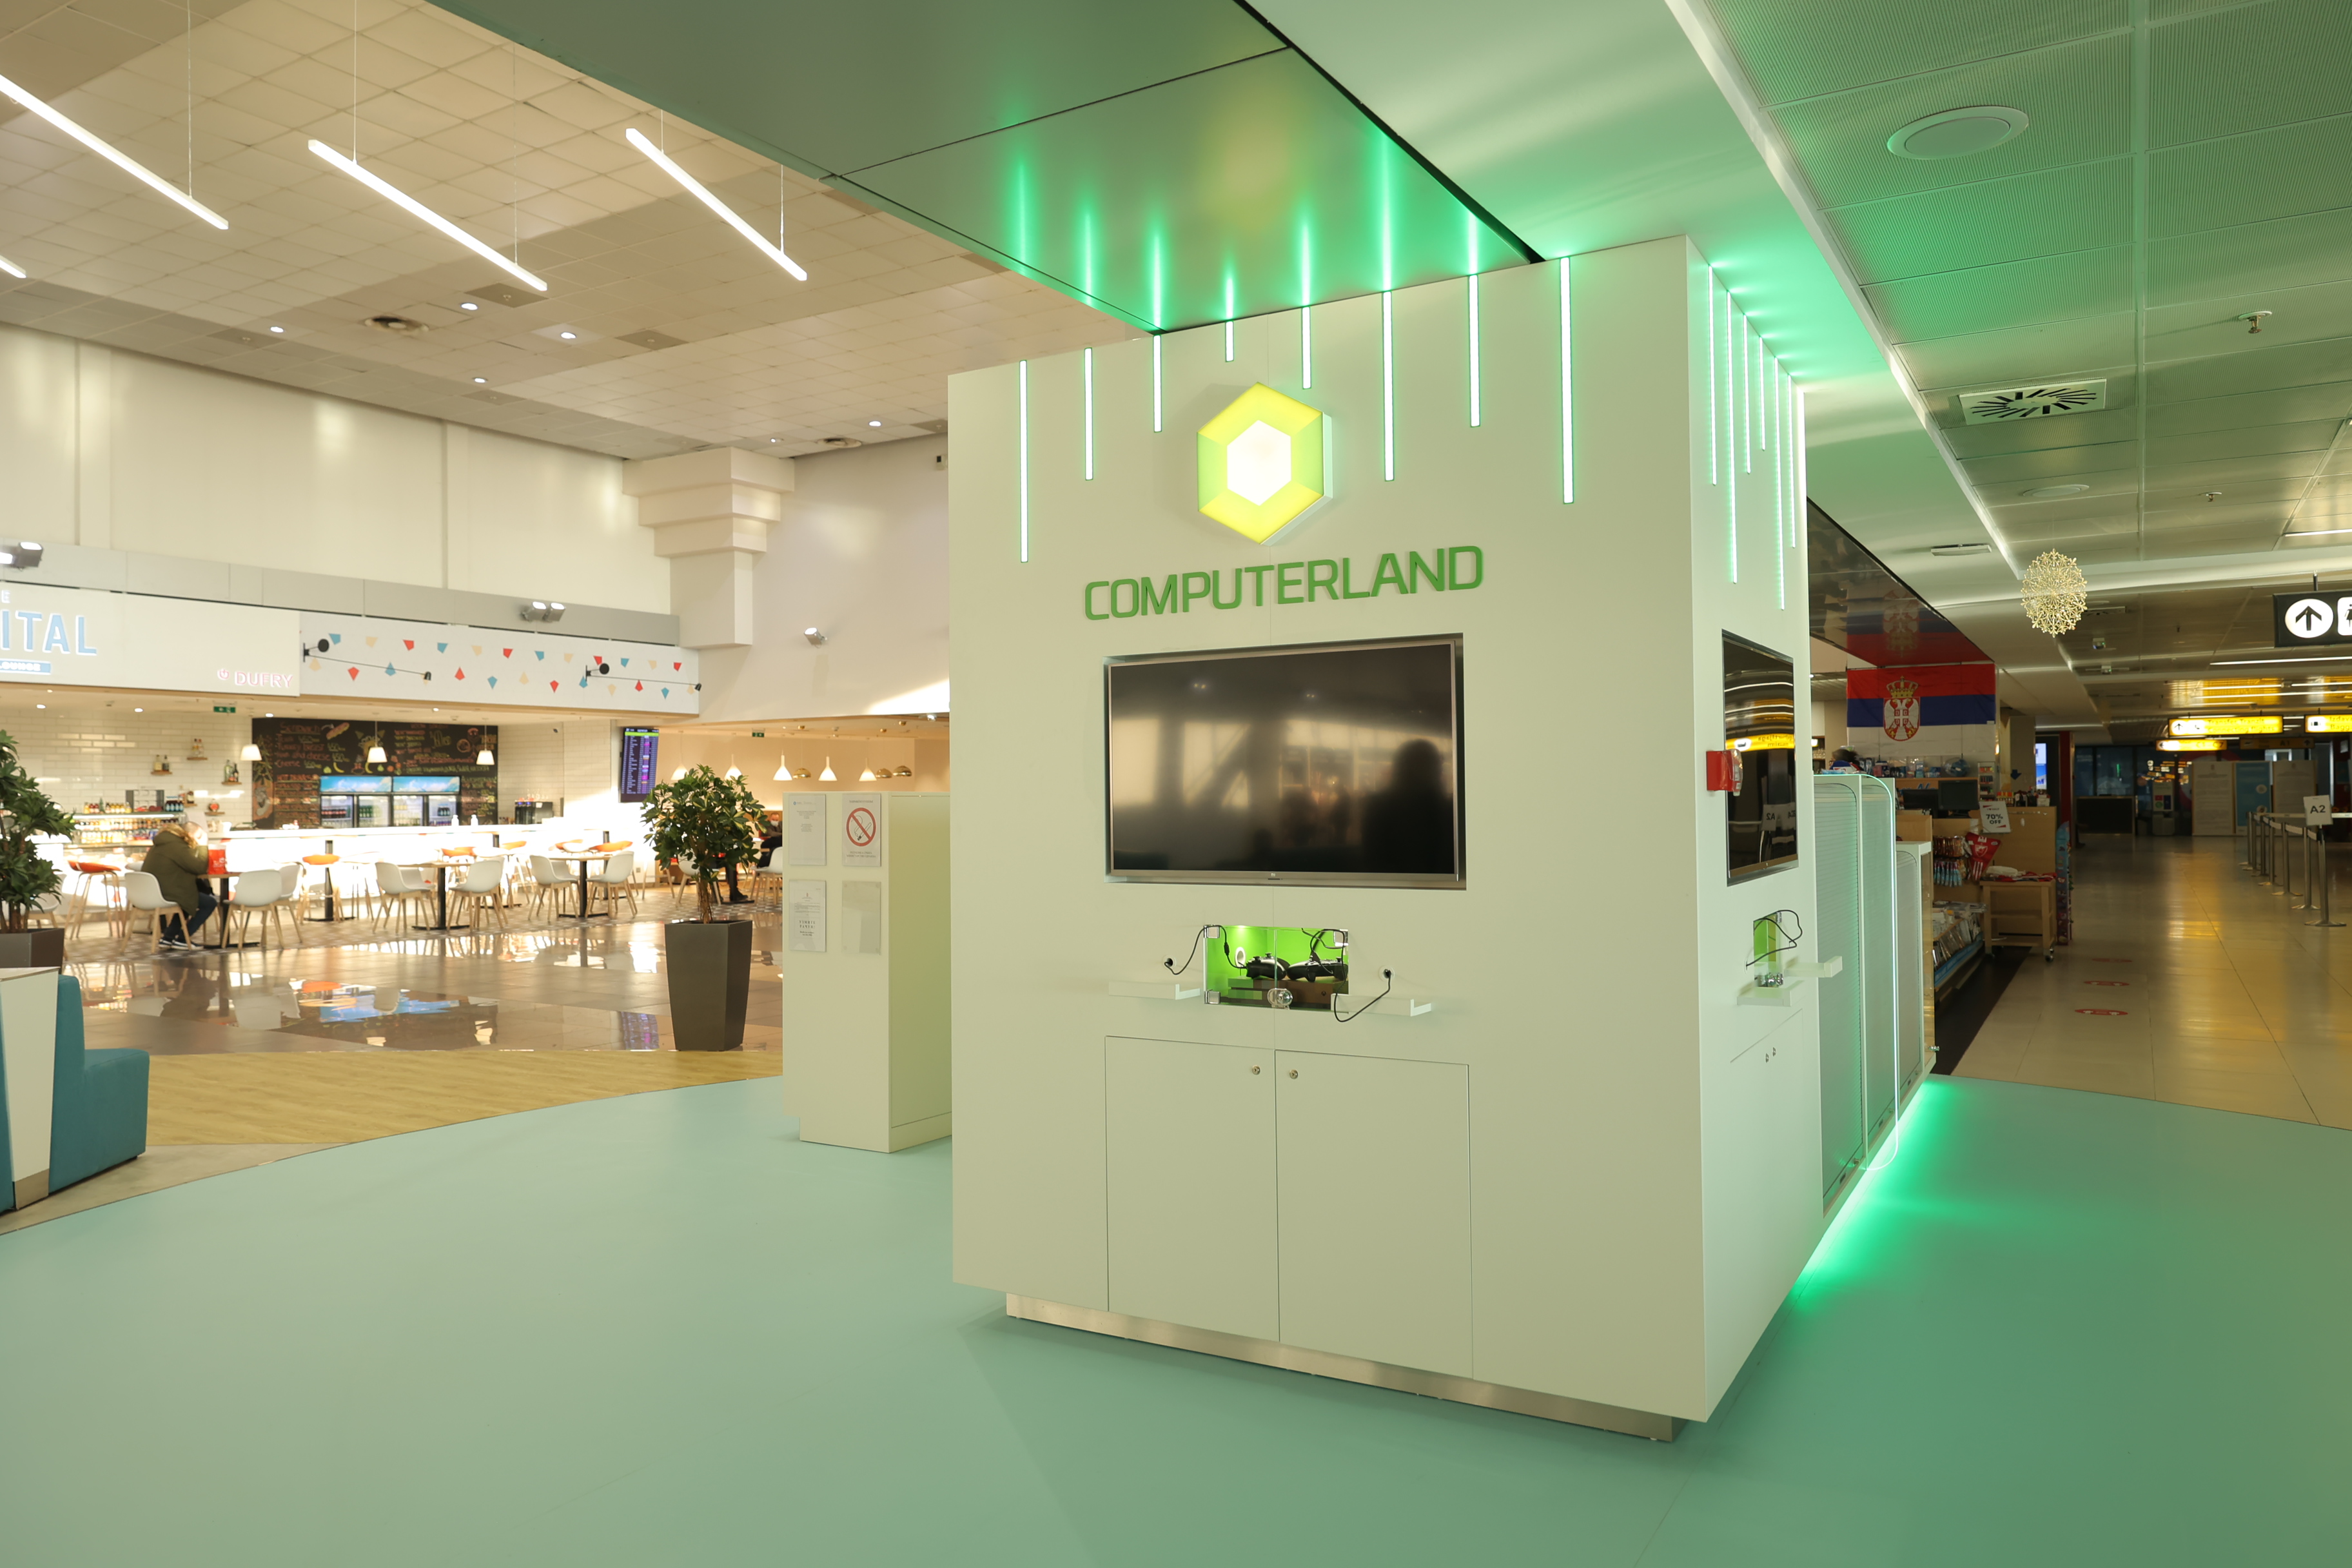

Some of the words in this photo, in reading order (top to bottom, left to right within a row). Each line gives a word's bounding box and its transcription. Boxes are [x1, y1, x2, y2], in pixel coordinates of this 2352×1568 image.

[1084, 545, 1484, 620] COMPUTERLAND
[235, 671, 293, 688] DUFRY
[2310, 805, 2326, 814] A2
